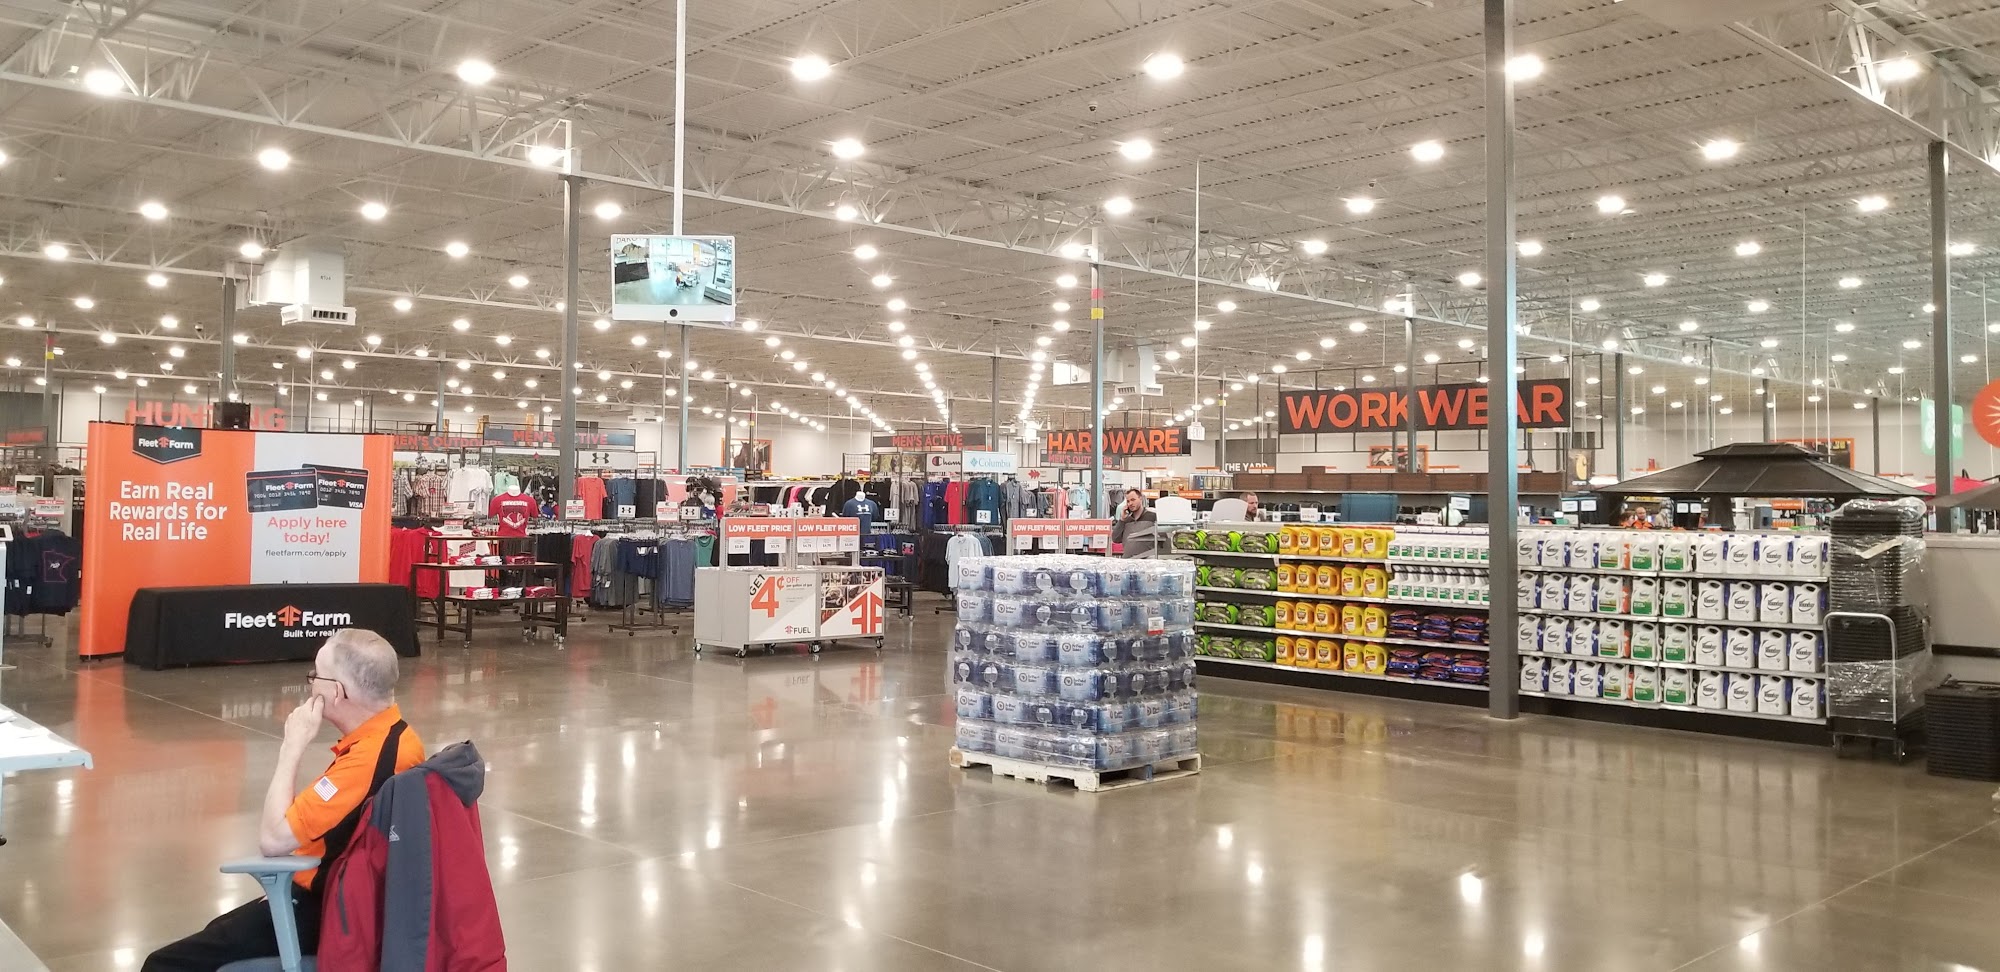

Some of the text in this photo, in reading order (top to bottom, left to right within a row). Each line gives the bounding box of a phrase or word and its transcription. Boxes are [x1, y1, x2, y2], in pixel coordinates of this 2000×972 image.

[513, 430, 608, 445] MEN'S TIVE
[892, 434, 963, 447] MEN'S ACTIVE
[138, 437, 194, 449] Fleet Farm
[979, 459, 1011, 467] Columbia
[1225, 463, 1240, 472] THE
[266, 482, 314, 492] Fleet Farm
[318, 479, 337, 487] Fleet
[120, 481, 214, 500] Earn Real
[109, 502, 227, 520] Rewards for
[268, 516, 347, 530] Apply here
[122, 521, 208, 541] Real Life
[728, 524, 792, 532] LOW FLEET PRICE
[798, 524, 858, 532] LOW FLEET PRICE
[1014, 524, 1060, 532] LOW FLEET PRICE
[1066, 524, 1110, 532] LOW FLEET PRICE
[284, 532, 330, 545] today!
[266, 550, 347, 558] fleetfarm.com/apply
[786, 576, 800, 584] OFF
[225, 611, 350, 629] Fleet Farm
[284, 630, 304, 638] Built
[306, 630, 318, 638] for
[794, 626, 811, 634] FUEL
